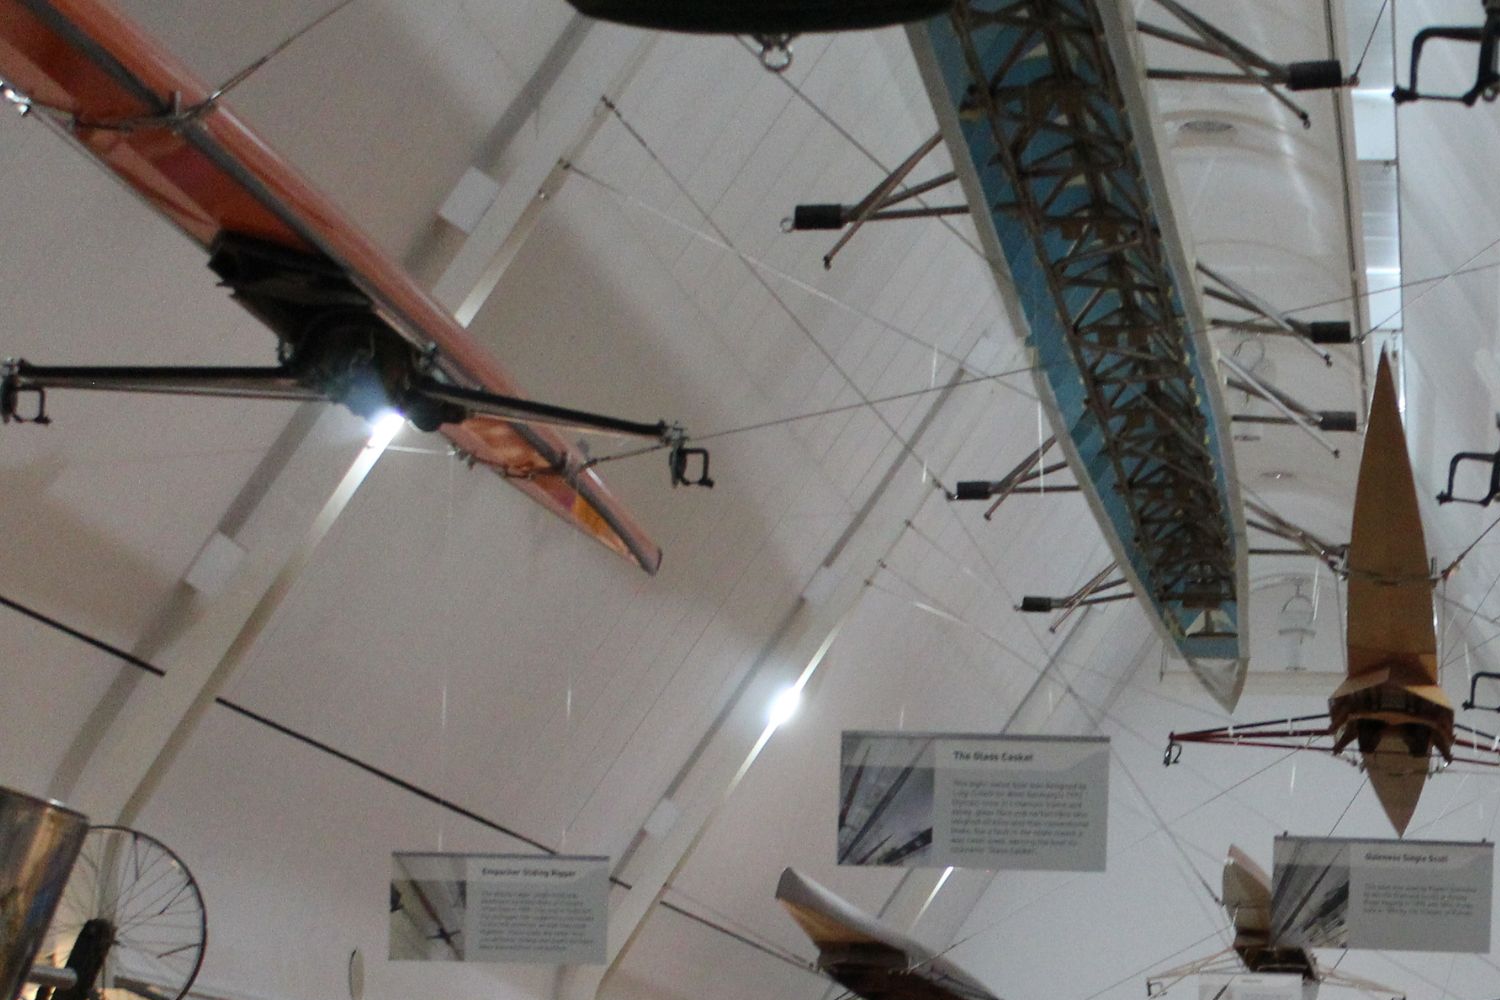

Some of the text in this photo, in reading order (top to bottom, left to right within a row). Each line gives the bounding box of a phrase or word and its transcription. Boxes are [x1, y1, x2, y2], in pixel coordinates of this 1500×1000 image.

[953, 750, 1034, 761] The Glass Casket
